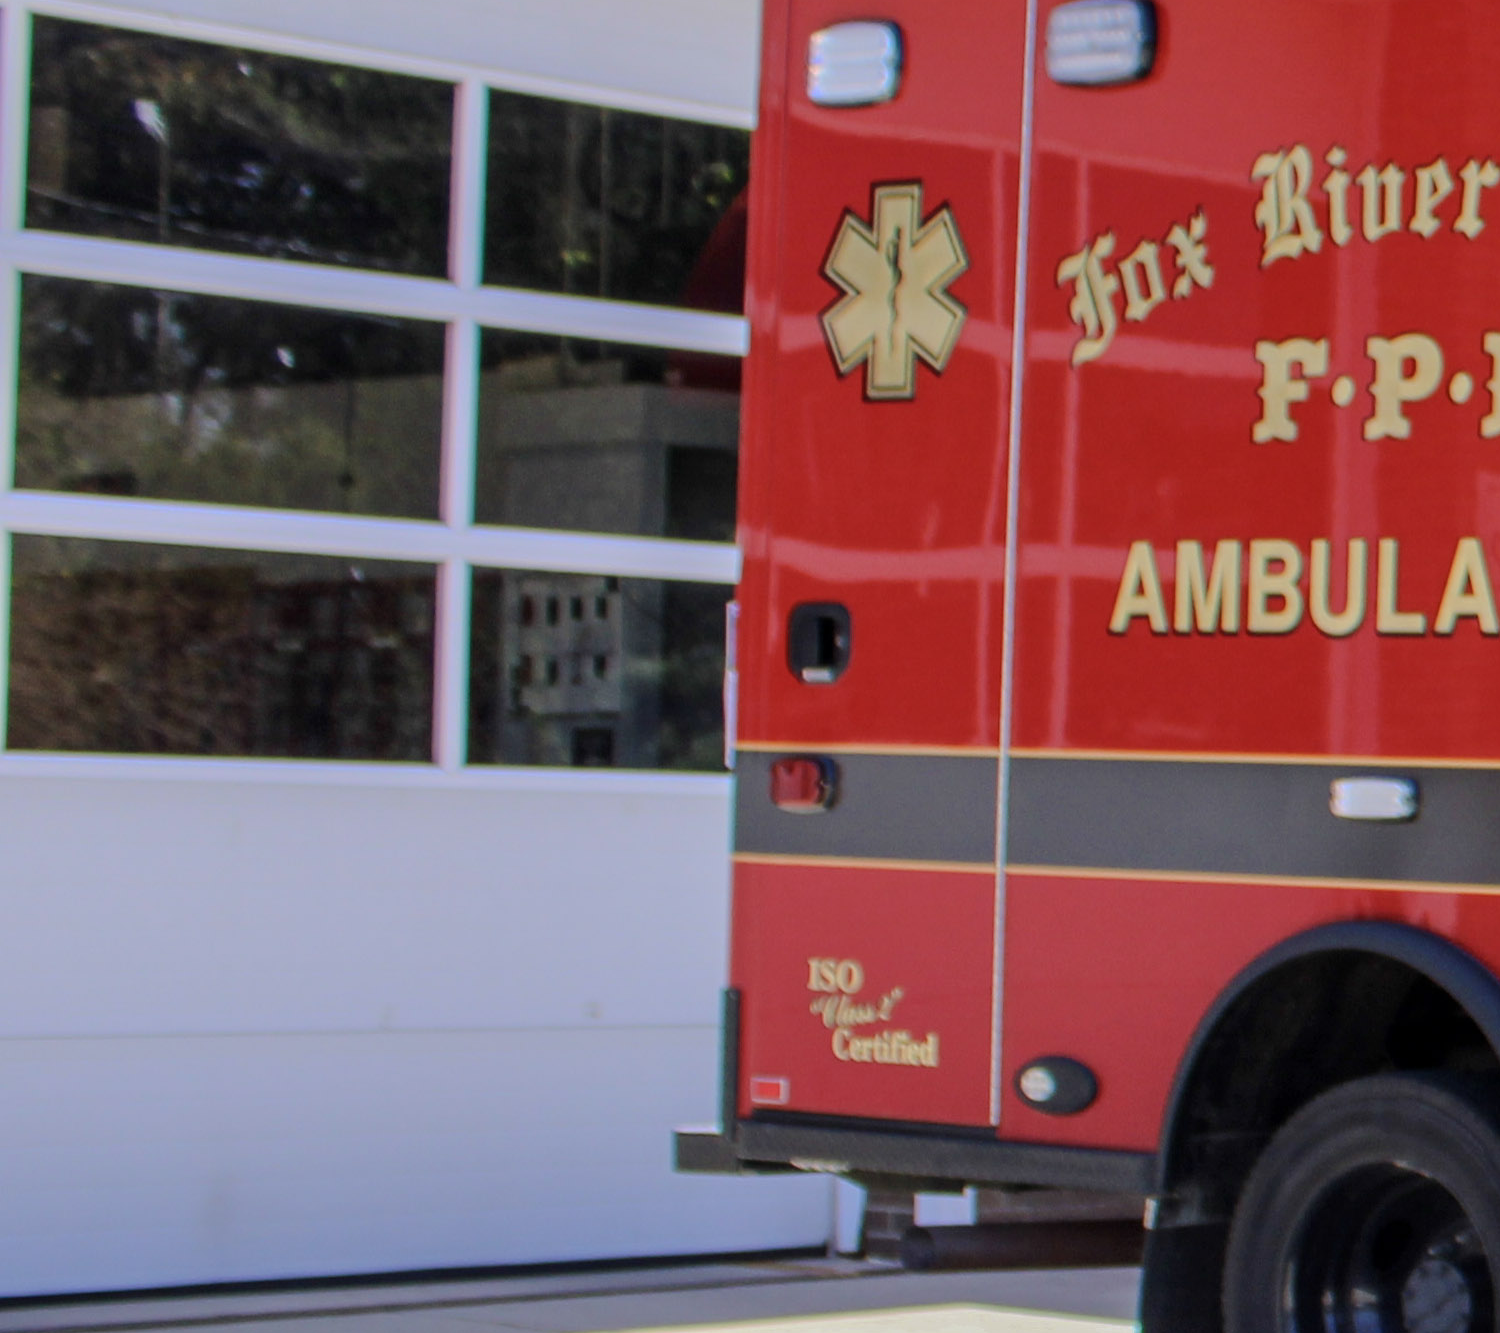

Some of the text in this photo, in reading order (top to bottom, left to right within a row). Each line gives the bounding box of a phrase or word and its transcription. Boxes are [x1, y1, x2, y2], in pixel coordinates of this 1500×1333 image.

[1057, 210, 1216, 366] Fox
[807, 958, 863, 994] ISO
[832, 1027, 940, 1067] Certified
